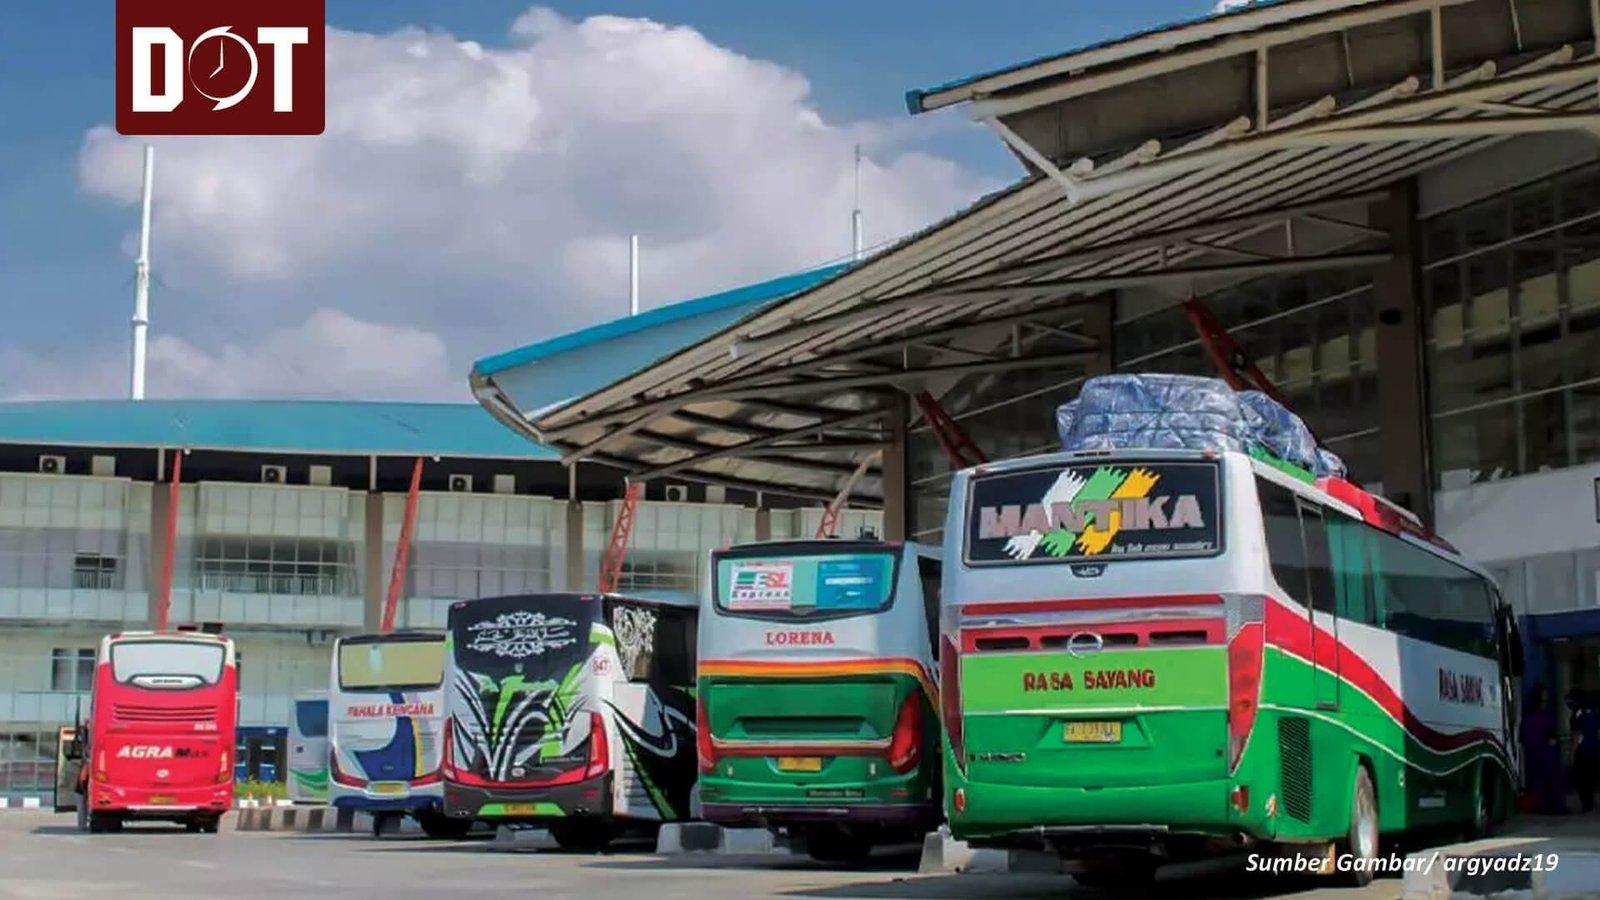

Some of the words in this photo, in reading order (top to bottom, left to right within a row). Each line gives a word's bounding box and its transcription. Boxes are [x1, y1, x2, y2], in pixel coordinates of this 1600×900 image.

[979, 495, 1205, 539] MANTIKA
[766, 632, 834, 645] LORENA
[1024, 672, 1073, 691] RASA
[1084, 670, 1156, 688] SAYANG
[386, 704, 434, 716] KENCANA
[116, 745, 173, 758] AGRA
